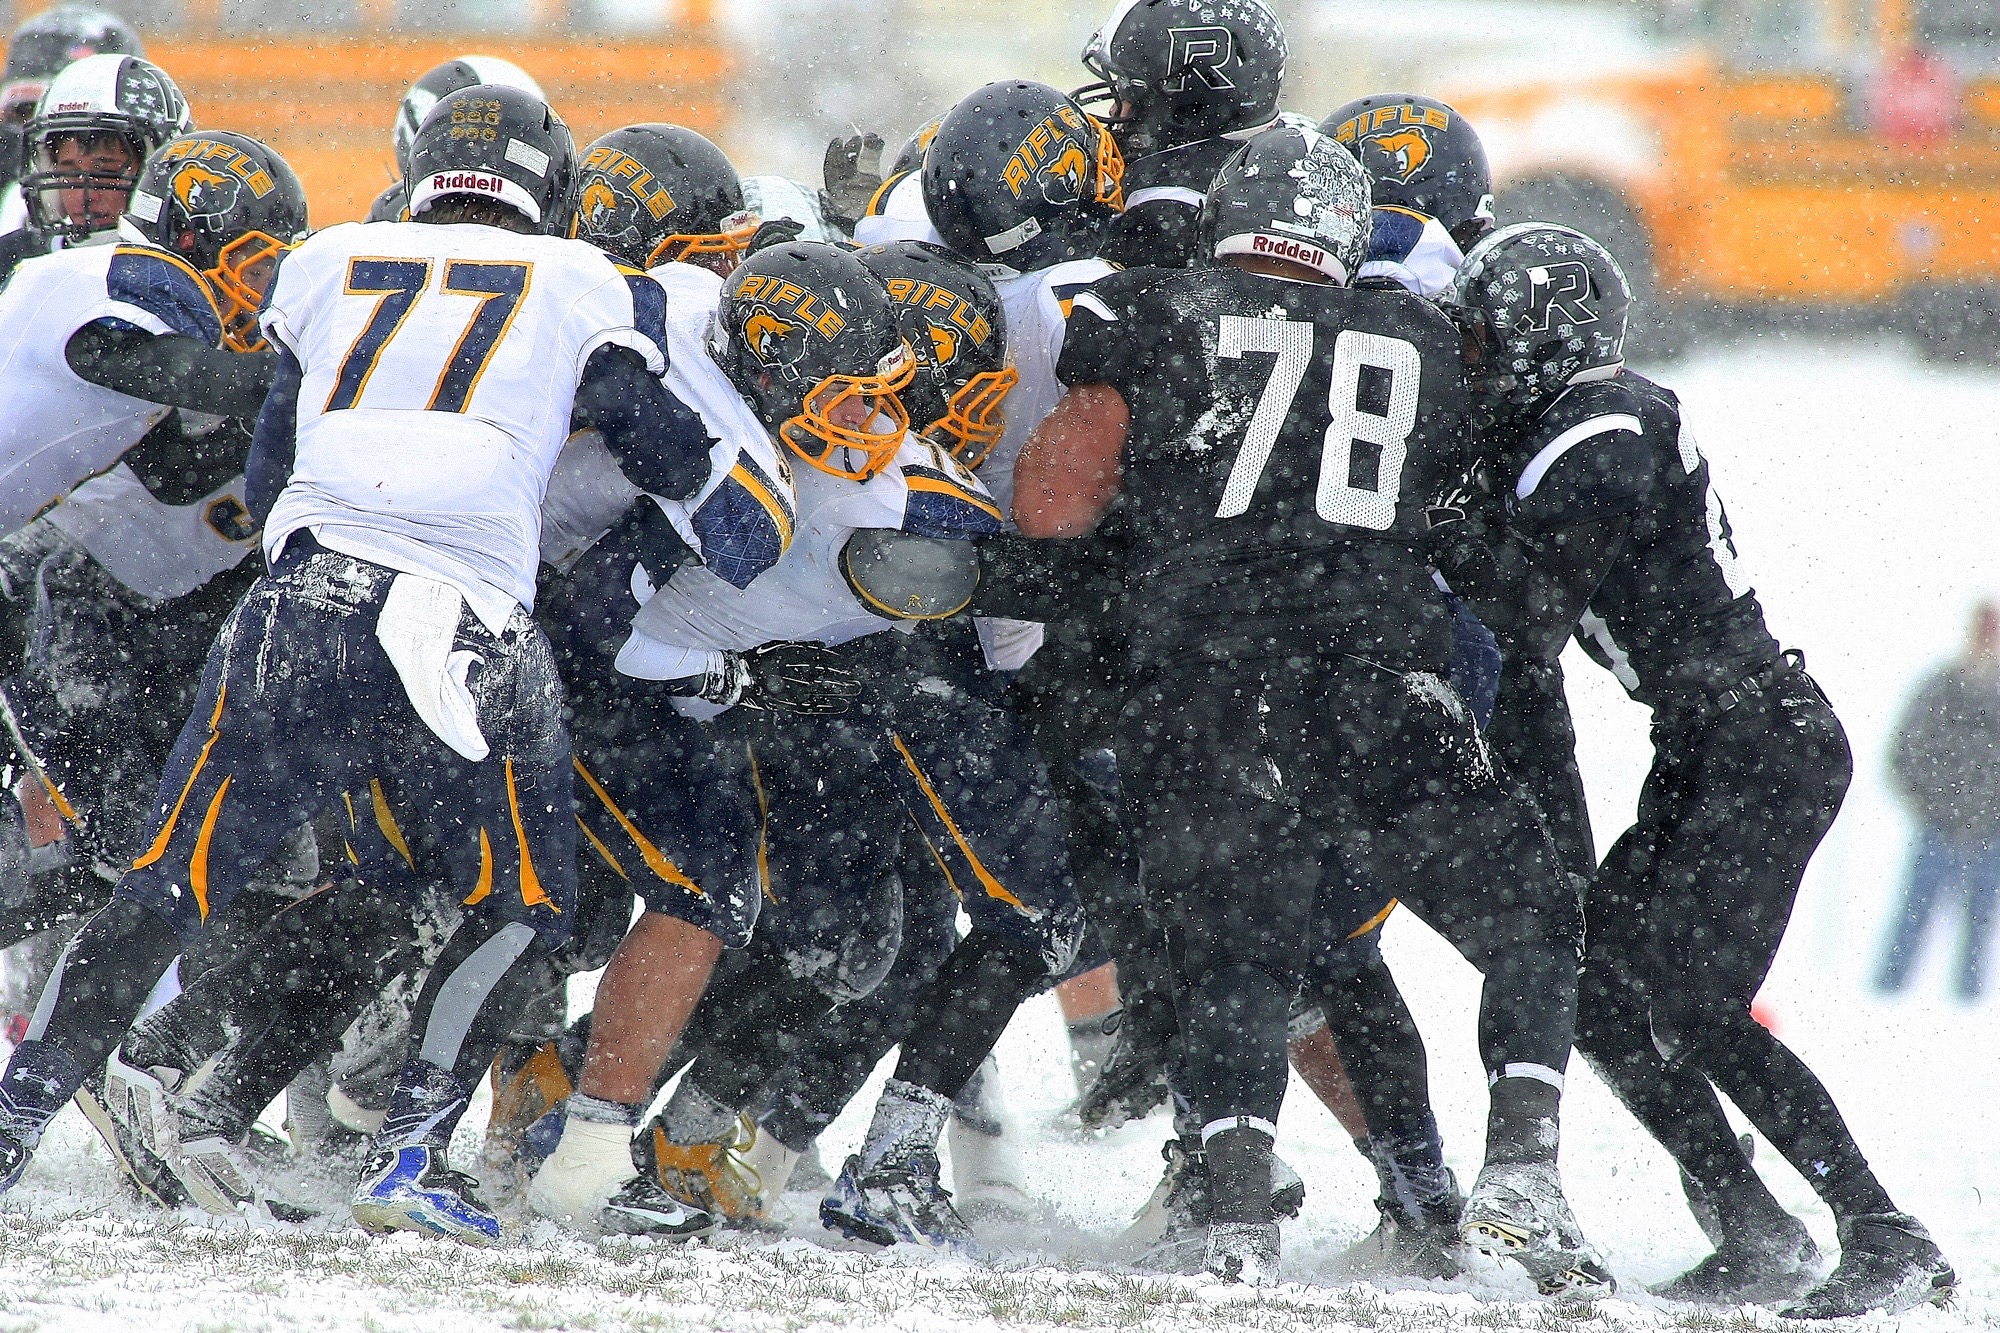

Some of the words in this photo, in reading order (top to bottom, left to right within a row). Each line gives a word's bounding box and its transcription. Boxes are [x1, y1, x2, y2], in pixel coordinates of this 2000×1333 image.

[999, 103, 1083, 200] RIFLE
[1335, 104, 1449, 144] RIFLE
[162, 140, 275, 199] RIFLE
[433, 174, 503, 193] Riddell
[580, 147, 678, 222] RIFLE
[1253, 235, 1325, 266] Riddell
[320, 256, 535, 415] 77
[735, 275, 848, 343] RIFLE
[884, 277, 992, 350] RIFLE
[1214, 314, 1422, 531] 78
